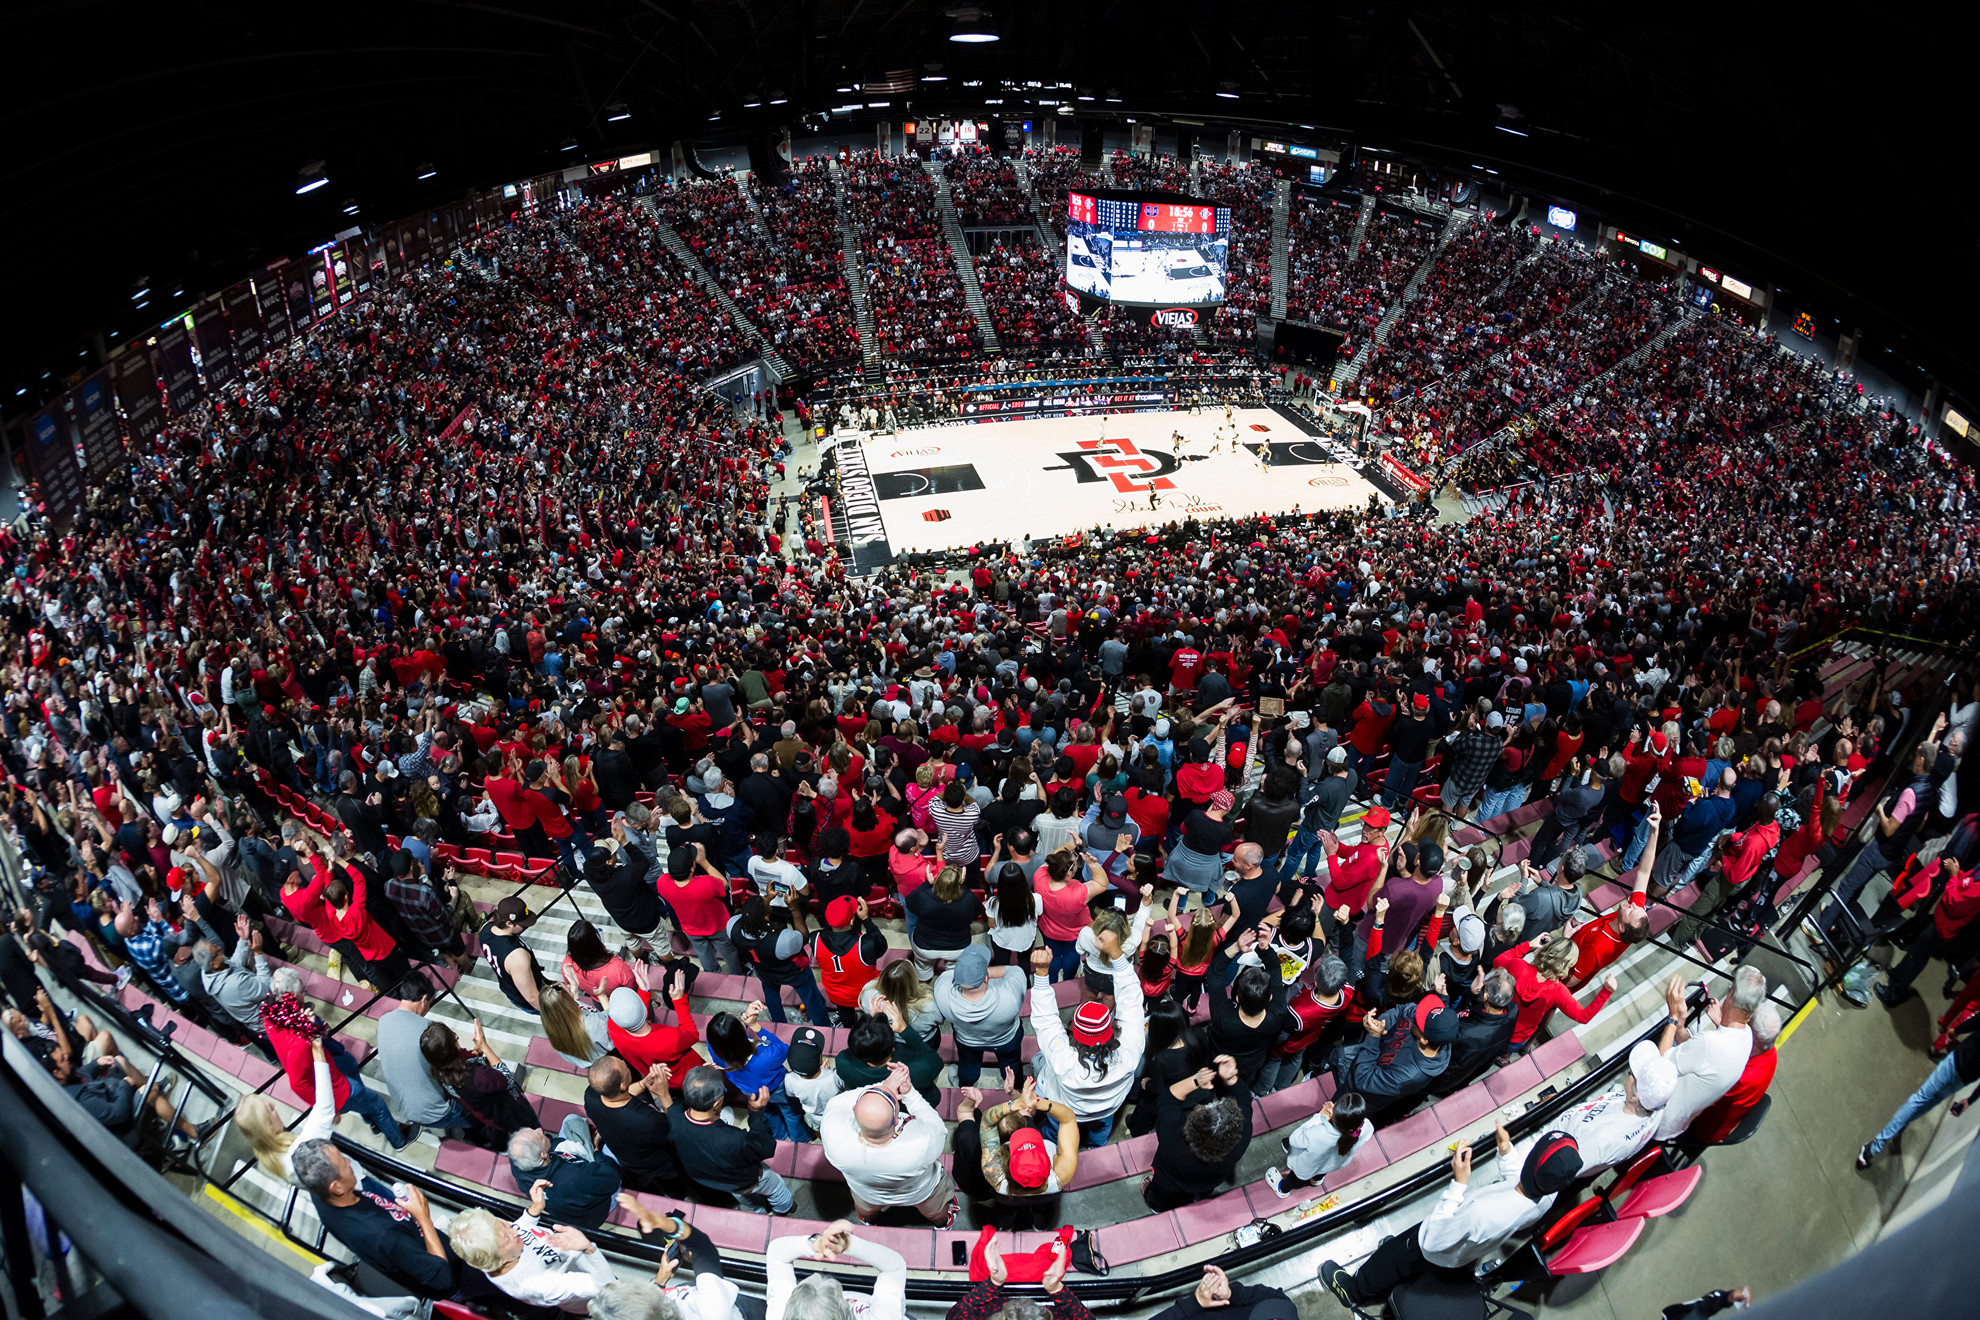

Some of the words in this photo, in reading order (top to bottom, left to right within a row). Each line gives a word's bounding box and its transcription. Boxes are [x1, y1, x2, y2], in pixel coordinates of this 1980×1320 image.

[1169, 206, 1193, 217] 18:56
[1148, 219, 1155, 230] 0
[1202, 222, 1208, 233] 0
[1624, 237, 1640, 247] TOYOTA
[1641, 241, 1665, 258] COX
[261, 292, 281, 309] WAC
[1156, 310, 1194, 328] VIEJAS
[272, 328, 287, 343] 1985
[244, 345, 261, 361] 1978
[211, 365, 229, 383] 1977
[176, 389, 196, 408] 1976
[979, 403, 1000, 411] OFFICIAL
[139, 416, 159, 437] 1941
[841, 477, 880, 516] DIEGO
[1184, 505, 1224, 514] COURT
[849, 516, 886, 544] SAN
[1503, 714, 1520, 728] 15
[831, 954, 844, 973] 1
[532, 1244, 563, 1265] SAN
